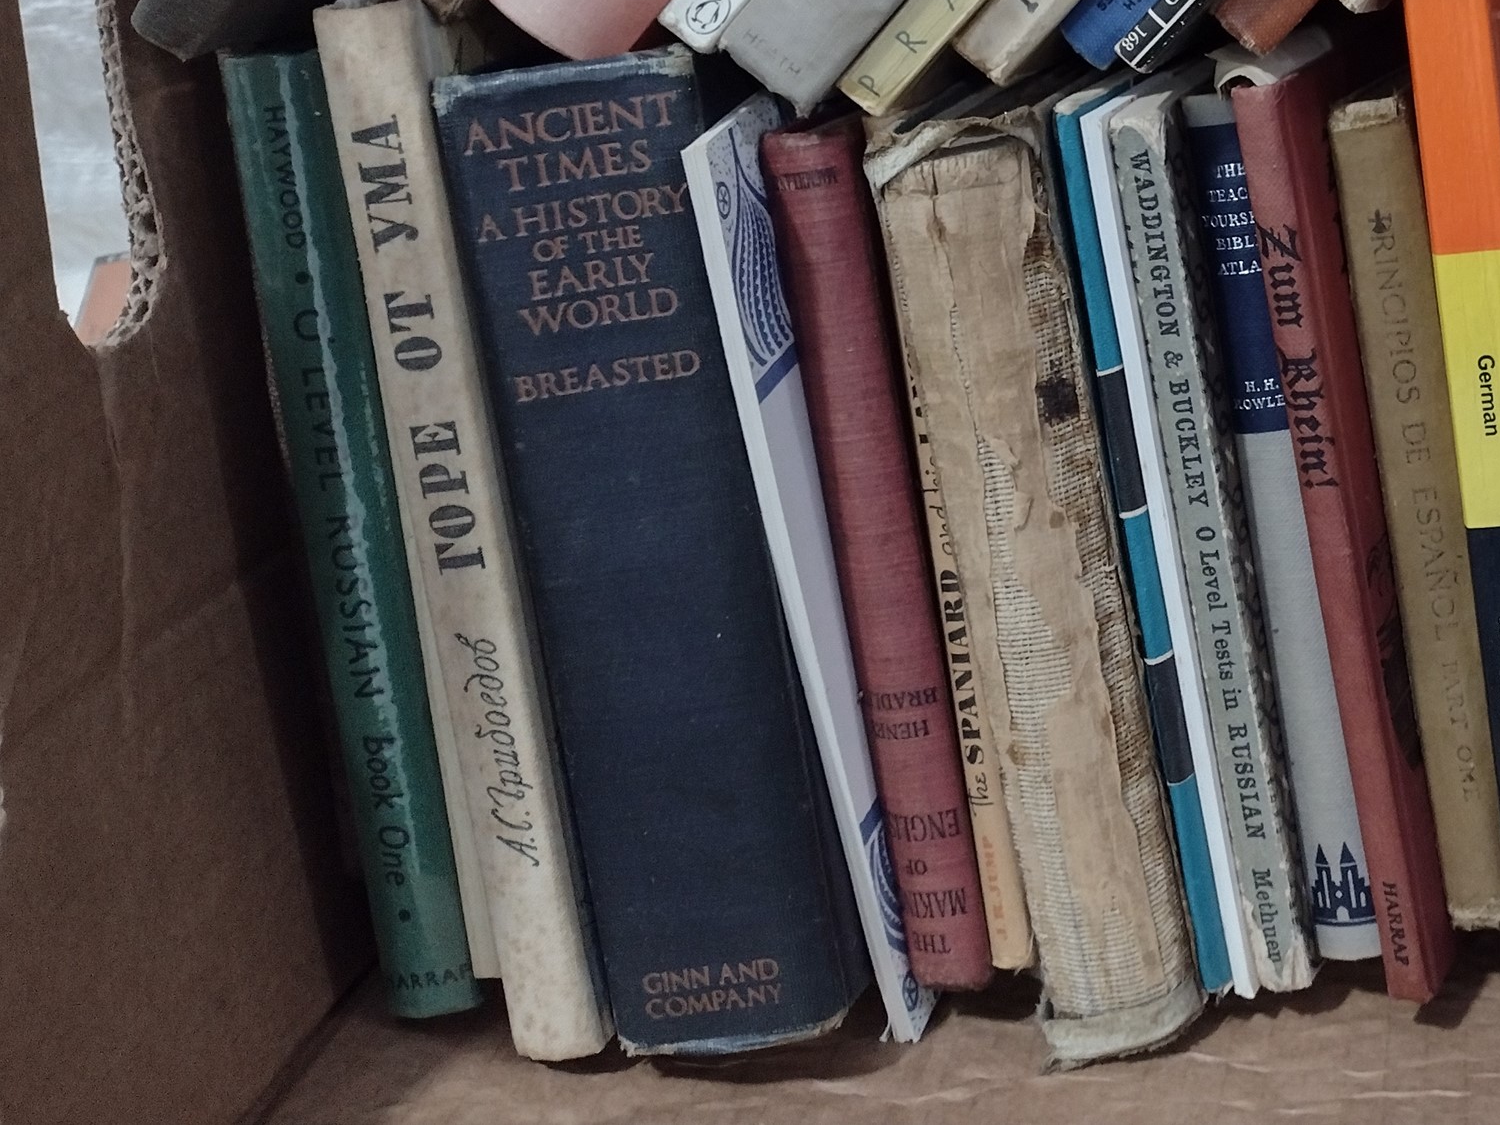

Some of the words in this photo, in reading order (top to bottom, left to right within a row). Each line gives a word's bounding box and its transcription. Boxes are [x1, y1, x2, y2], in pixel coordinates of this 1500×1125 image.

[1120, 22, 1150, 54] 168
[463, 90, 678, 156] ANCIENT
[351, 113, 419, 254] УМА
[497, 138, 652, 192] TIMES
[477, 212, 508, 243] A
[510, 181, 688, 238] HISTORY
[1129, 148, 1181, 339] WADDINGTON
[532, 234, 570, 263] OF
[578, 225, 645, 255] THE
[528, 252, 654, 302] EARLY
[1257, 223, 1305, 329] Zum
[384, 290, 443, 372] ОТ
[517, 287, 678, 337] WORLD
[513, 348, 702, 404] BREASTED
[1163, 349, 1185, 371] &
[1476, 353, 1498, 437] German
[1168, 378, 1210, 510] BUCKLEY
[1401, 421, 1432, 465] DE
[263, 104, 307, 250] HAYWOOD
[301, 366, 343, 492] LEVEL
[325, 514, 385, 700] RUSSIAN
[378, 825, 410, 887] One
[409, 420, 487, 574] ГОРЕ
[1195, 525, 1216, 543] O
[1199, 549, 1229, 612] Level
[939, 568, 986, 766] SPANIARD
[1210, 619, 1236, 683] Tests
[1221, 685, 1244, 711] in
[1227, 722, 1267, 842] RUSSIAN
[1251, 867, 1286, 966] Methuen
[1382, 879, 1410, 967] HARRAP
[641, 965, 711, 997] GINN
[719, 957, 781, 990] AND
[644, 983, 785, 1019] COMPANY
